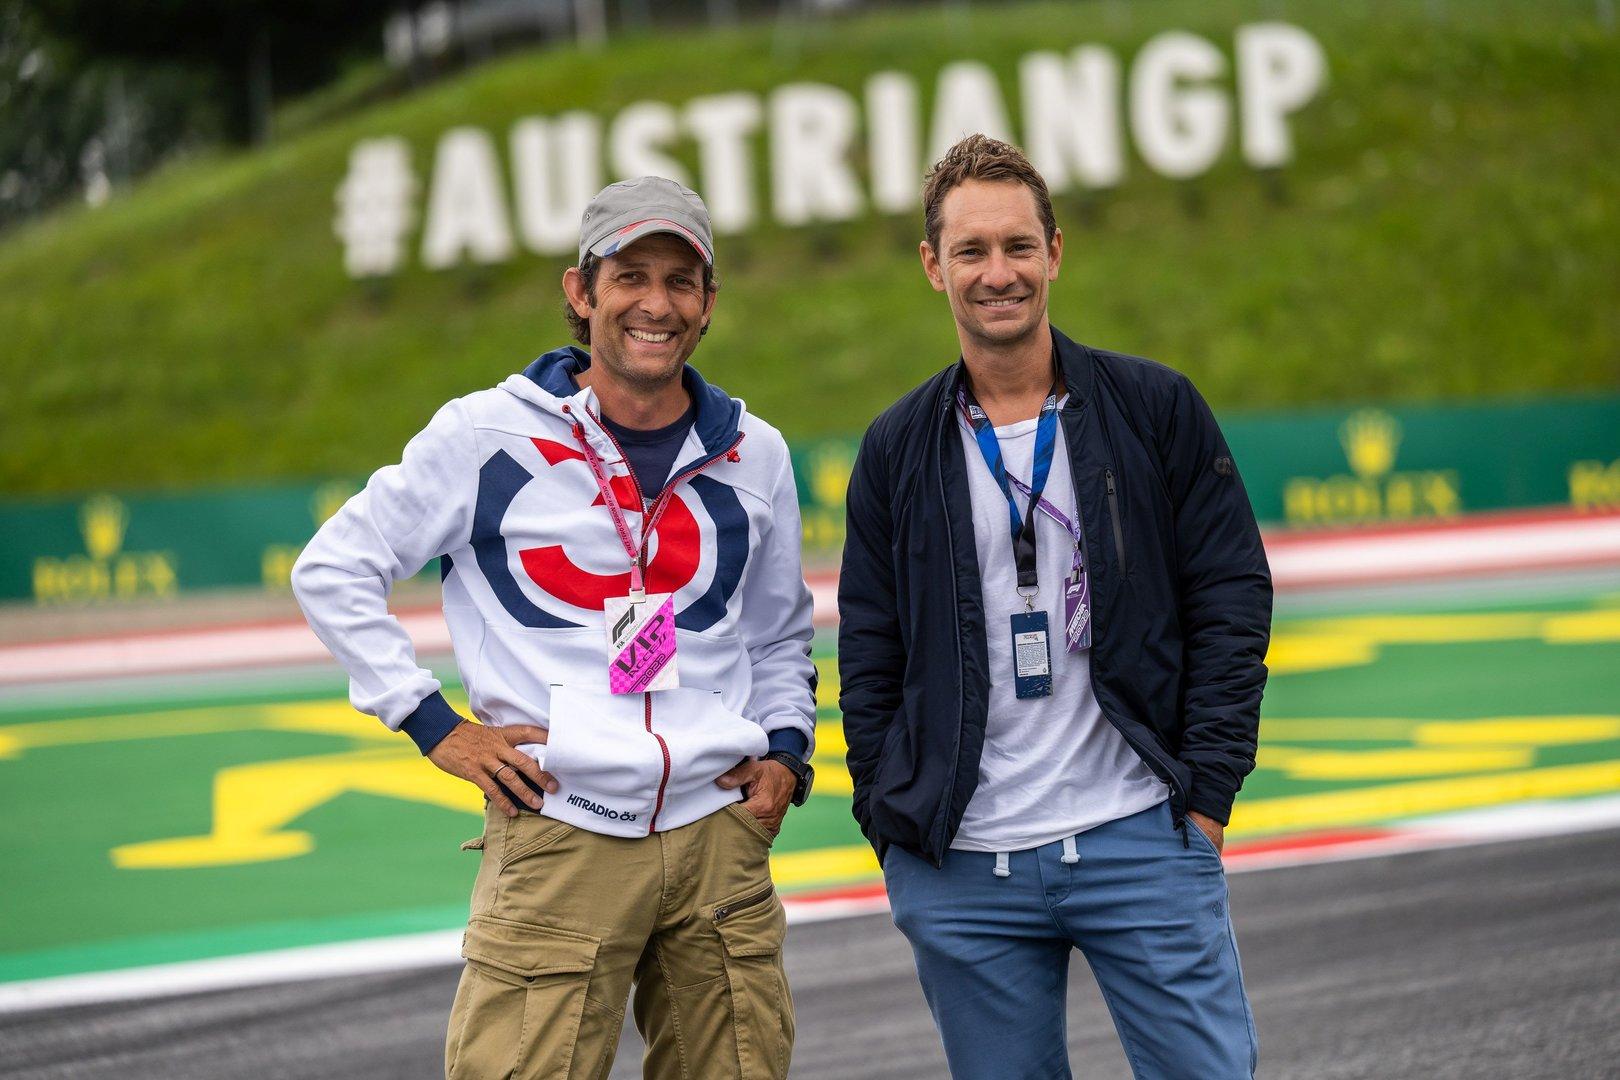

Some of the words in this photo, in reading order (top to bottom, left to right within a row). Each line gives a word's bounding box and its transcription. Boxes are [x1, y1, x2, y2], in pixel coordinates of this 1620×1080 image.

[336, 22, 1328, 277] #AUSTRIANGP
[616, 614, 665, 674] VIP
[628, 632, 667, 678] ACCESS
[642, 653, 666, 686] 2022
[566, 793, 619, 819] HITRADIO
